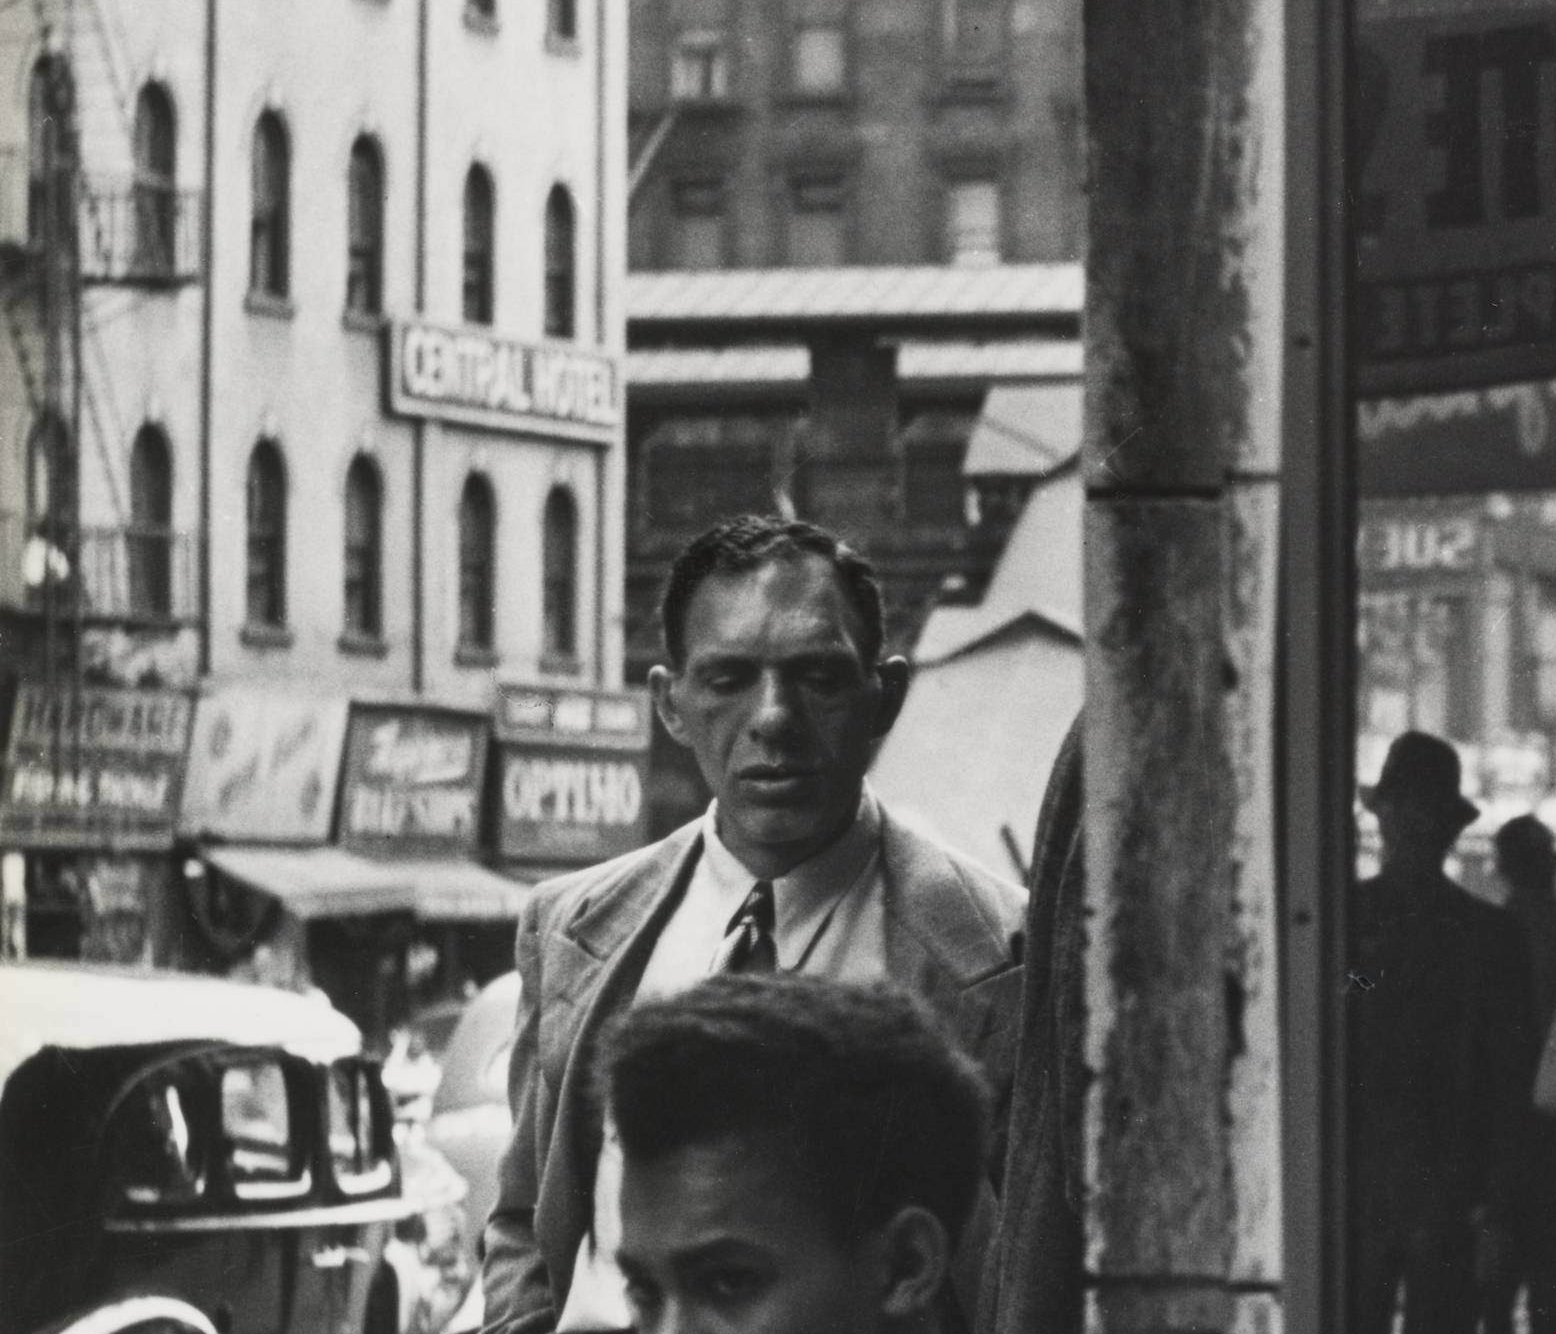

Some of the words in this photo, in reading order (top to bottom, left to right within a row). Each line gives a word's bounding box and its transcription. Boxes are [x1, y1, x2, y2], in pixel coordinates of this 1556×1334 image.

[405, 327, 529, 410] CENTRAL
[532, 352, 618, 422] HOTEL
[505, 758, 640, 824] OPTIMO
